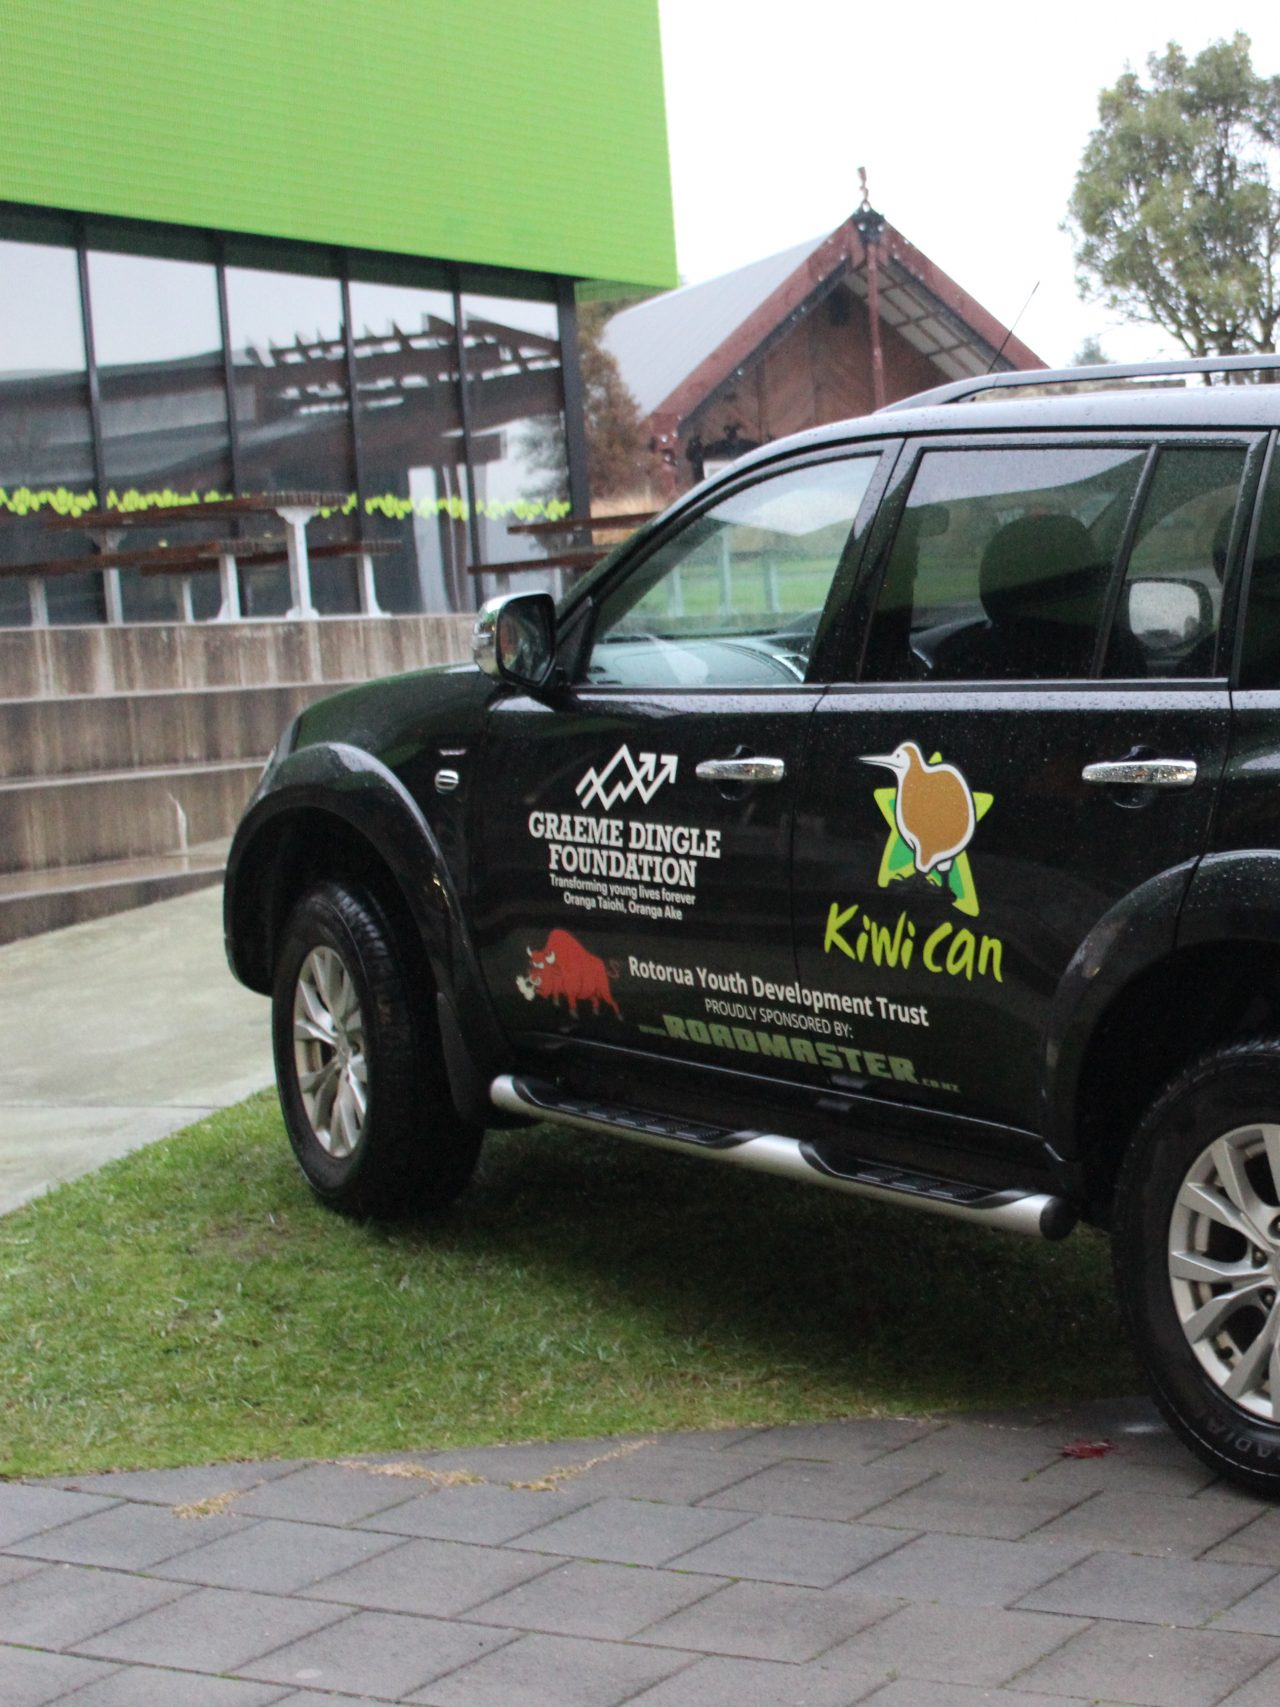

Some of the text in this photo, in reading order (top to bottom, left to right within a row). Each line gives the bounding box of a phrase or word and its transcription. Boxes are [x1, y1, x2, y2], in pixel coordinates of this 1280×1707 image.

[528, 811, 721, 859] GRAEME DINGLE
[549, 844, 697, 888] FOUNDATION
[549, 873, 696, 905] Transforming young lives forever
[563, 891, 596, 910] Oranga
[628, 900, 661, 919] Oranga
[664, 904, 683, 920] Ake
[628, 955, 930, 1027] Rotorua Youth Development Trust
[704, 998, 854, 1039] PROUDLY SPONSORED BY:
[662, 1014, 920, 1085] ROADMASTER
